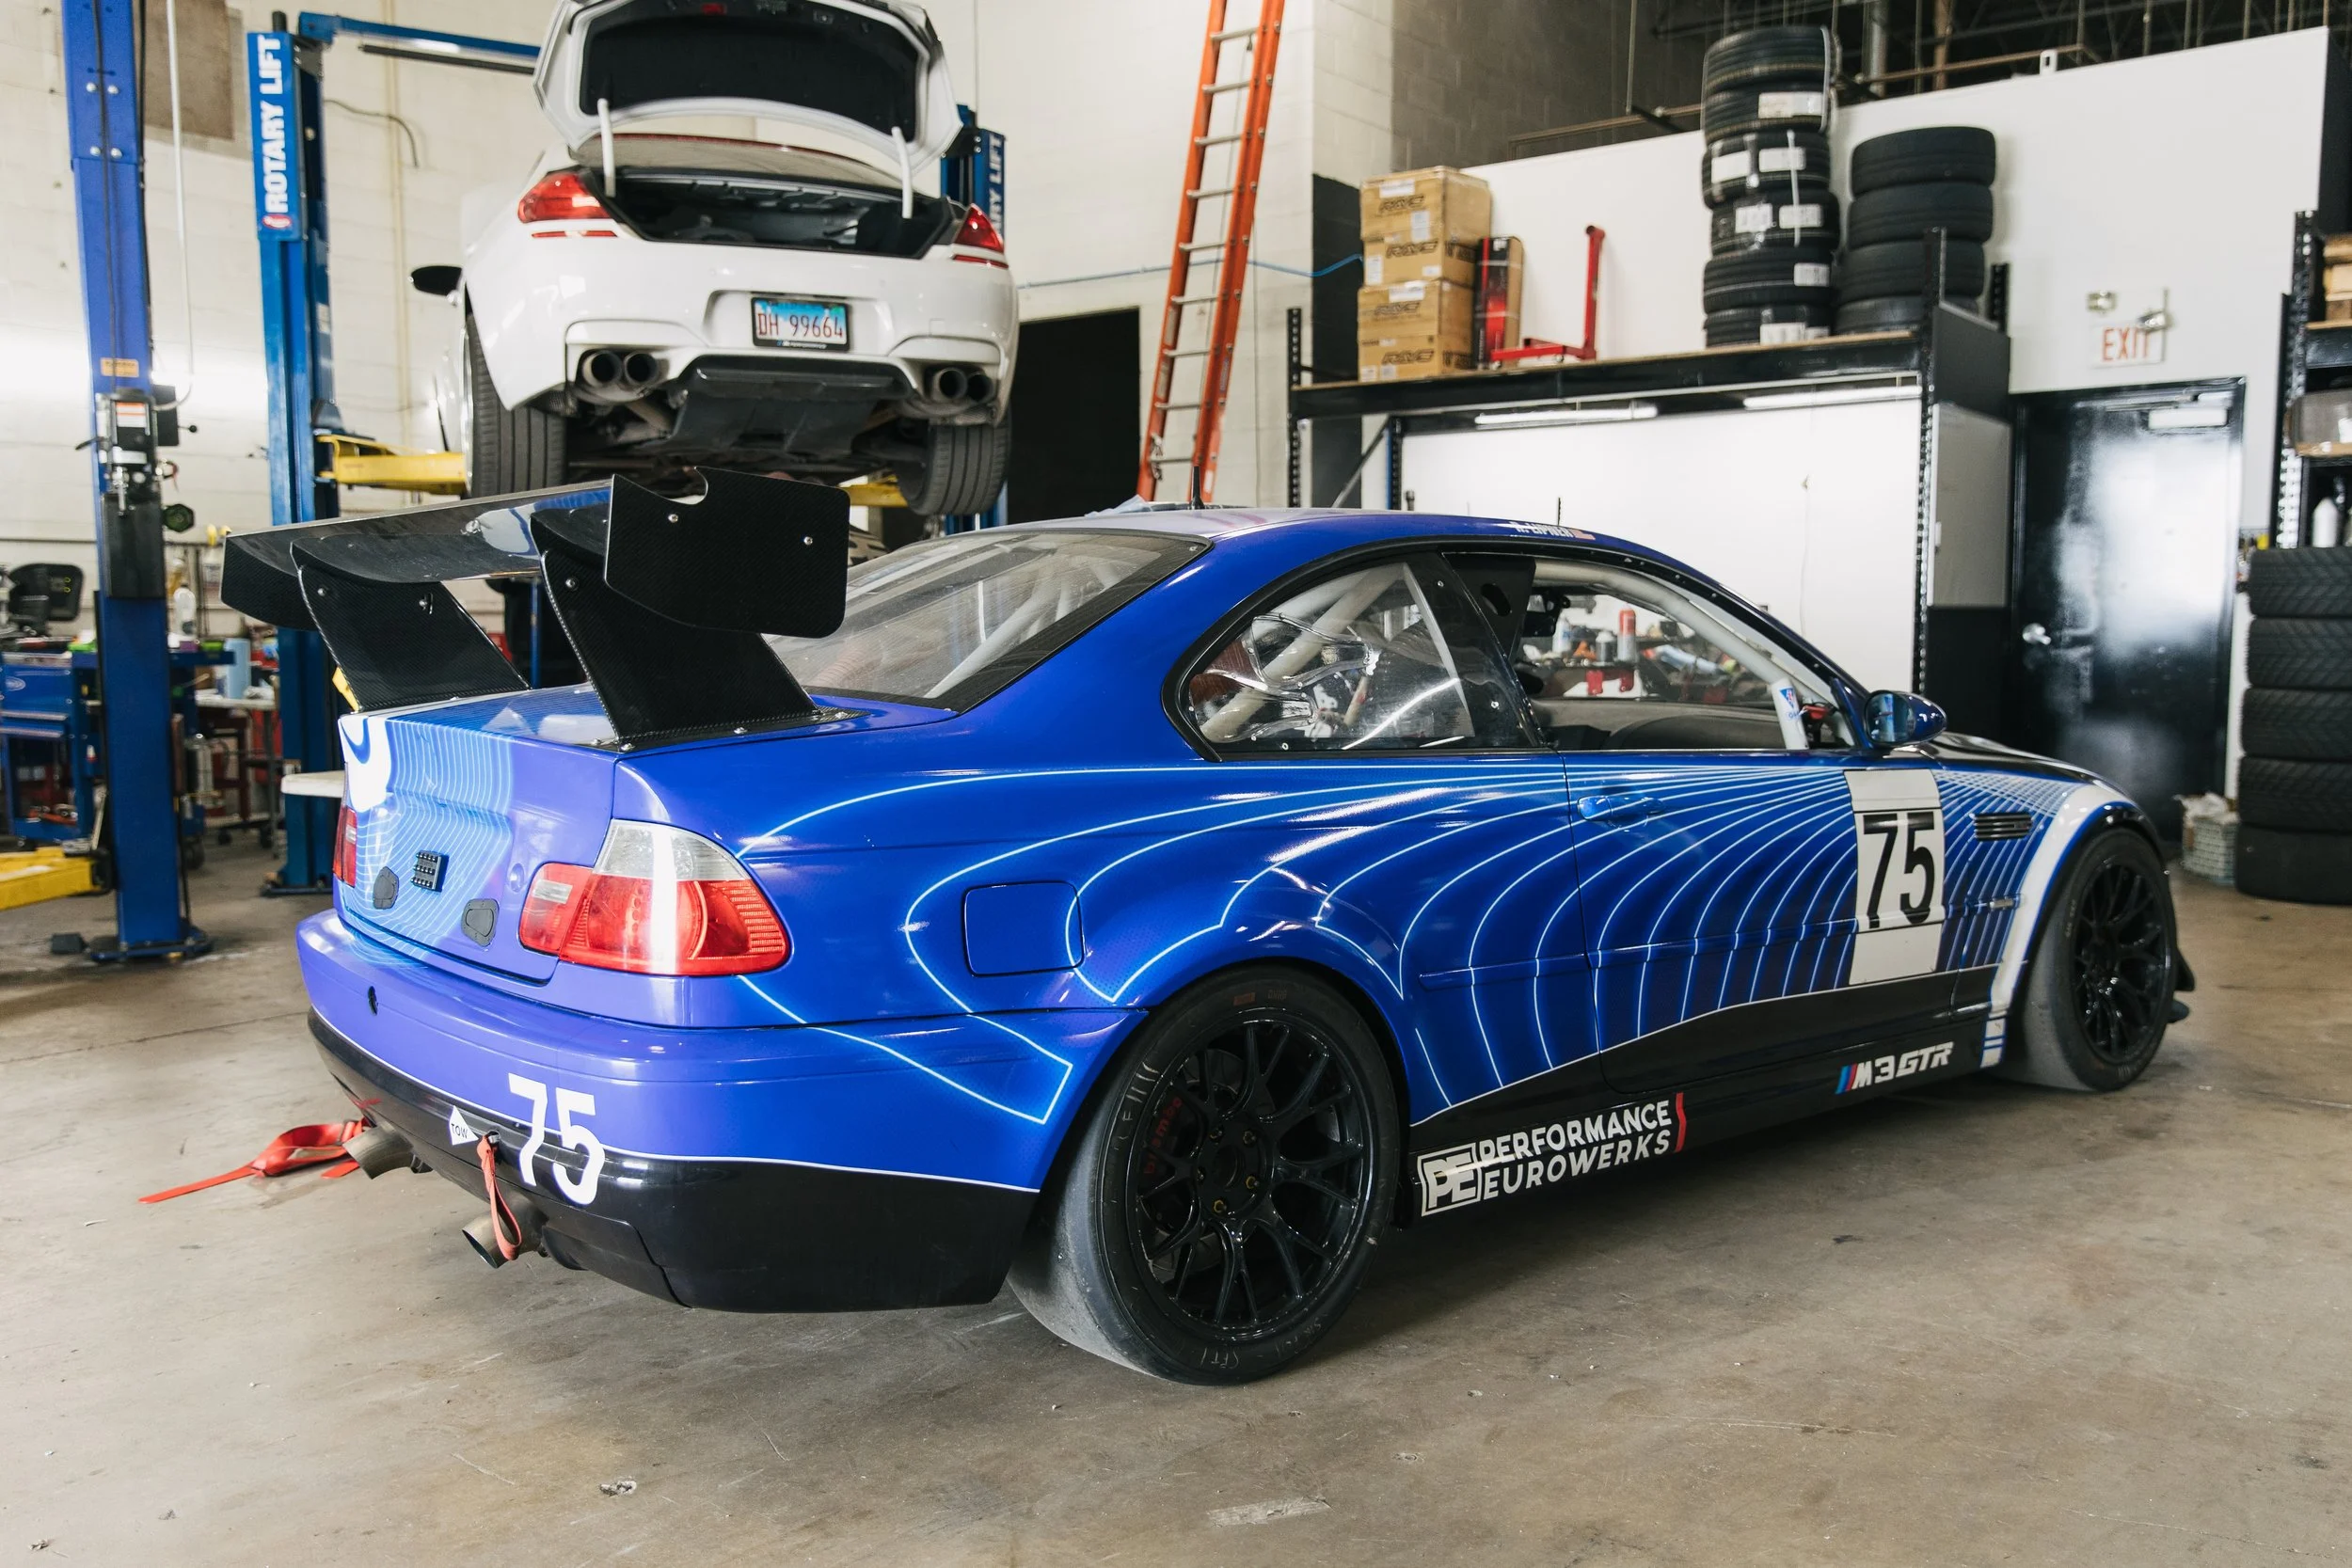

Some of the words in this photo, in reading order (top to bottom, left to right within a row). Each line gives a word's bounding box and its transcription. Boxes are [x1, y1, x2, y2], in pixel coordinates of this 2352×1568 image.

[257, 34, 282, 94] LIFT
[260, 101, 289, 214] ROTARY
[989, 133, 1002, 184] LIFT
[789, 314, 843, 338] 99664
[2101, 325, 2152, 362] EXIT
[1863, 811, 1935, 929] 75
[451, 1123, 469, 1139] TOW
[508, 1072, 605, 1205] 75
[1479, 1100, 1673, 1167] PERFORMANCE
[1423, 1151, 1478, 1209] PE
[1483, 1129, 1672, 1200] EUROWERKS
